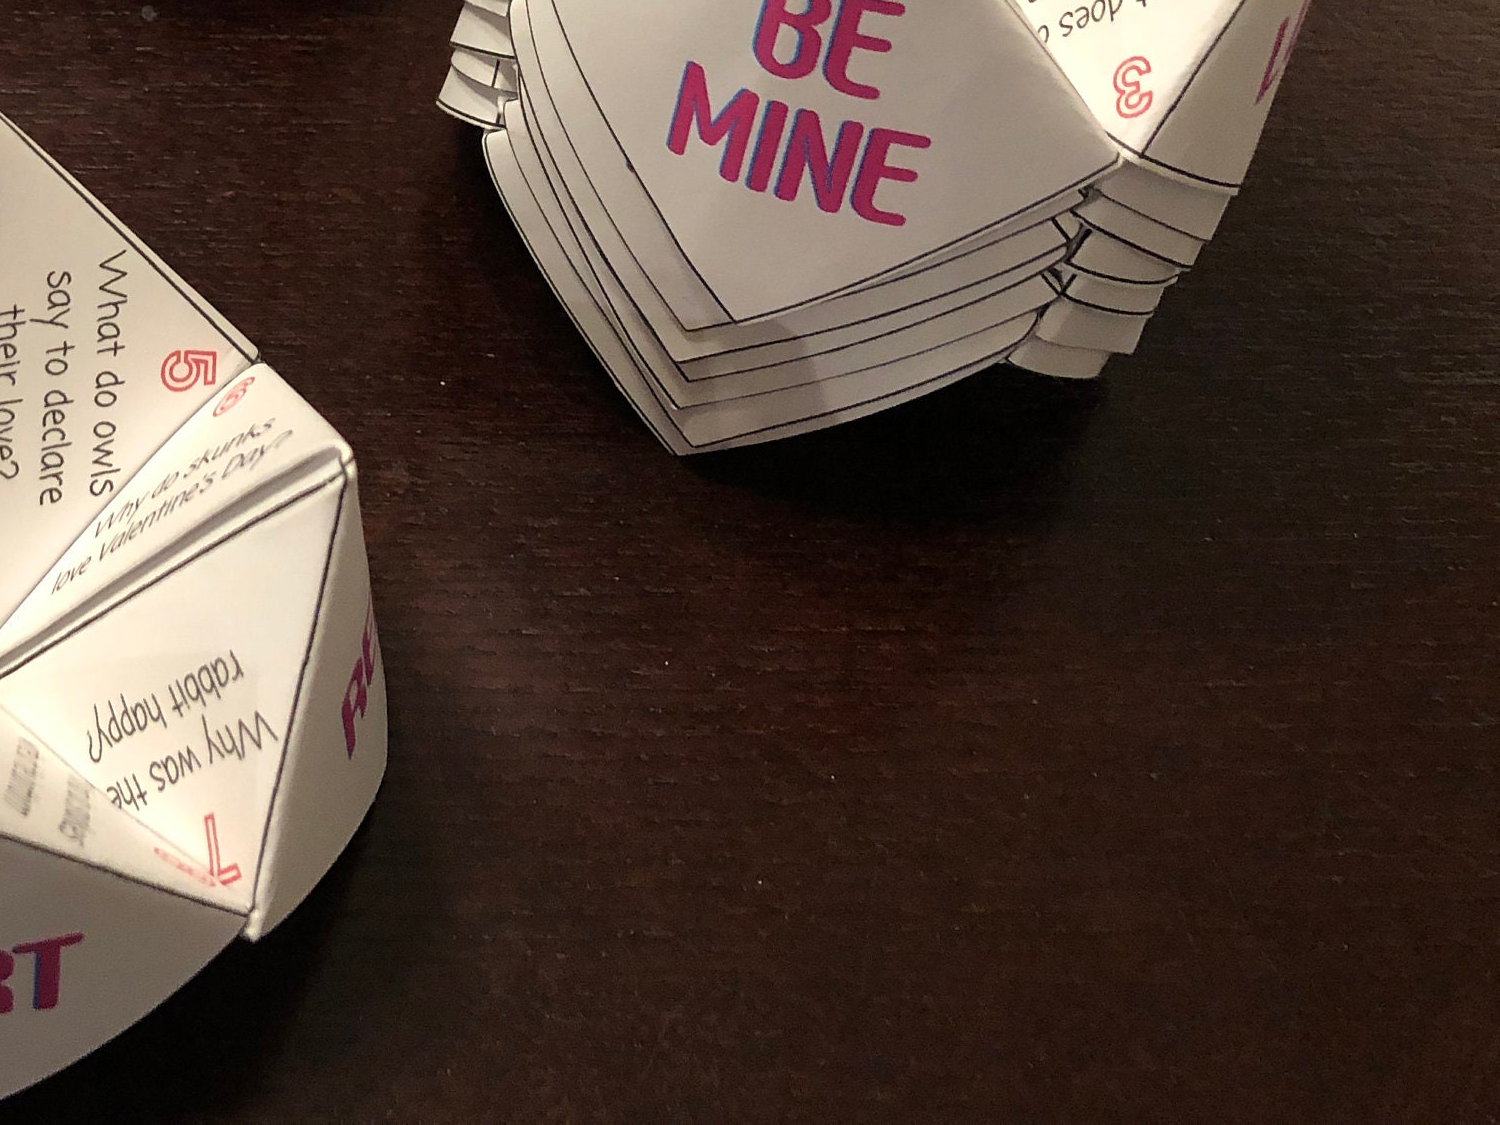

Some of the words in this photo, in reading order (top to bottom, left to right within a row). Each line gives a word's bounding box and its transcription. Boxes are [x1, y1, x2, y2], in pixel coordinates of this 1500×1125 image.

[1113, 55, 1153, 118] 3
[666, 60, 932, 227] MINE
[29, 270, 72, 328] say
[97, 249, 128, 357] What
[44, 341, 75, 376] to
[161, 349, 217, 392] 5
[94, 371, 126, 407] do
[39, 389, 74, 506] declare
[89, 421, 121, 497] owls
[94, 490, 150, 539] Why
[151, 472, 180, 499] do
[50, 555, 91, 595] love
[168, 649, 244, 718] rabbit
[86, 693, 168, 763] happy?
[201, 710, 279, 765] Why
[106, 773, 148, 812] the
[149, 745, 202, 792] was
